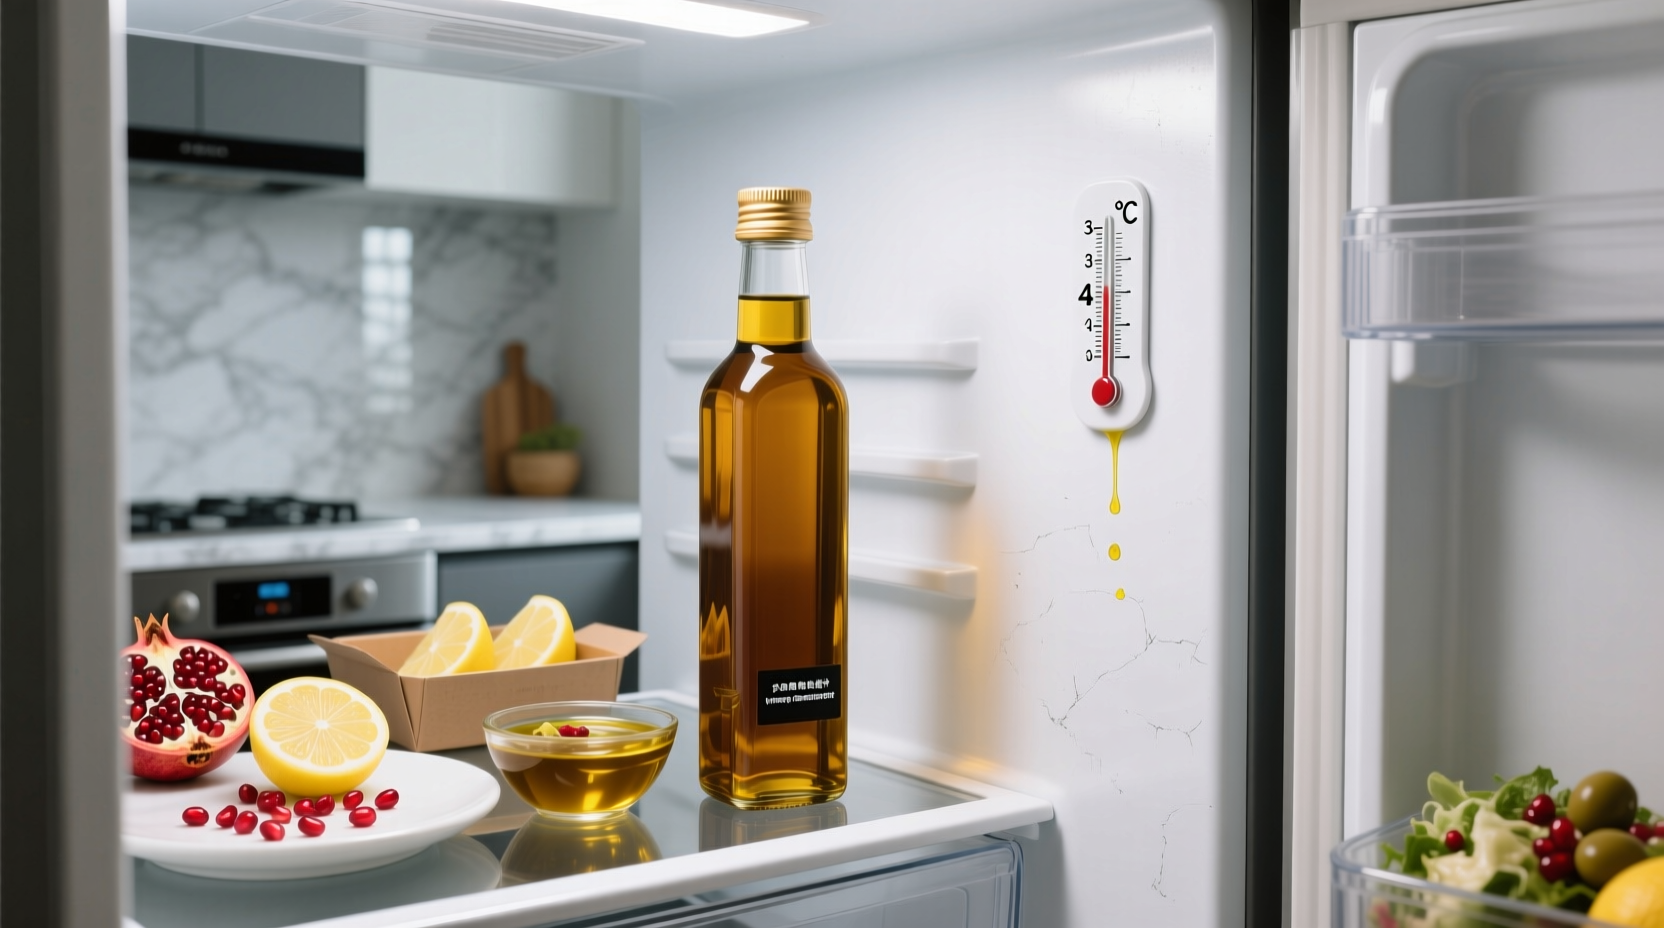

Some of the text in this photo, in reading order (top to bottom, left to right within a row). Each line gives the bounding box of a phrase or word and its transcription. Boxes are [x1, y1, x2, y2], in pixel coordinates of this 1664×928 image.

[1115, 200, 1138, 224] °C
[1083, 220, 1094, 235] 3
[1084, 253, 1093, 268] 3
[1078, 283, 1093, 306] 4
